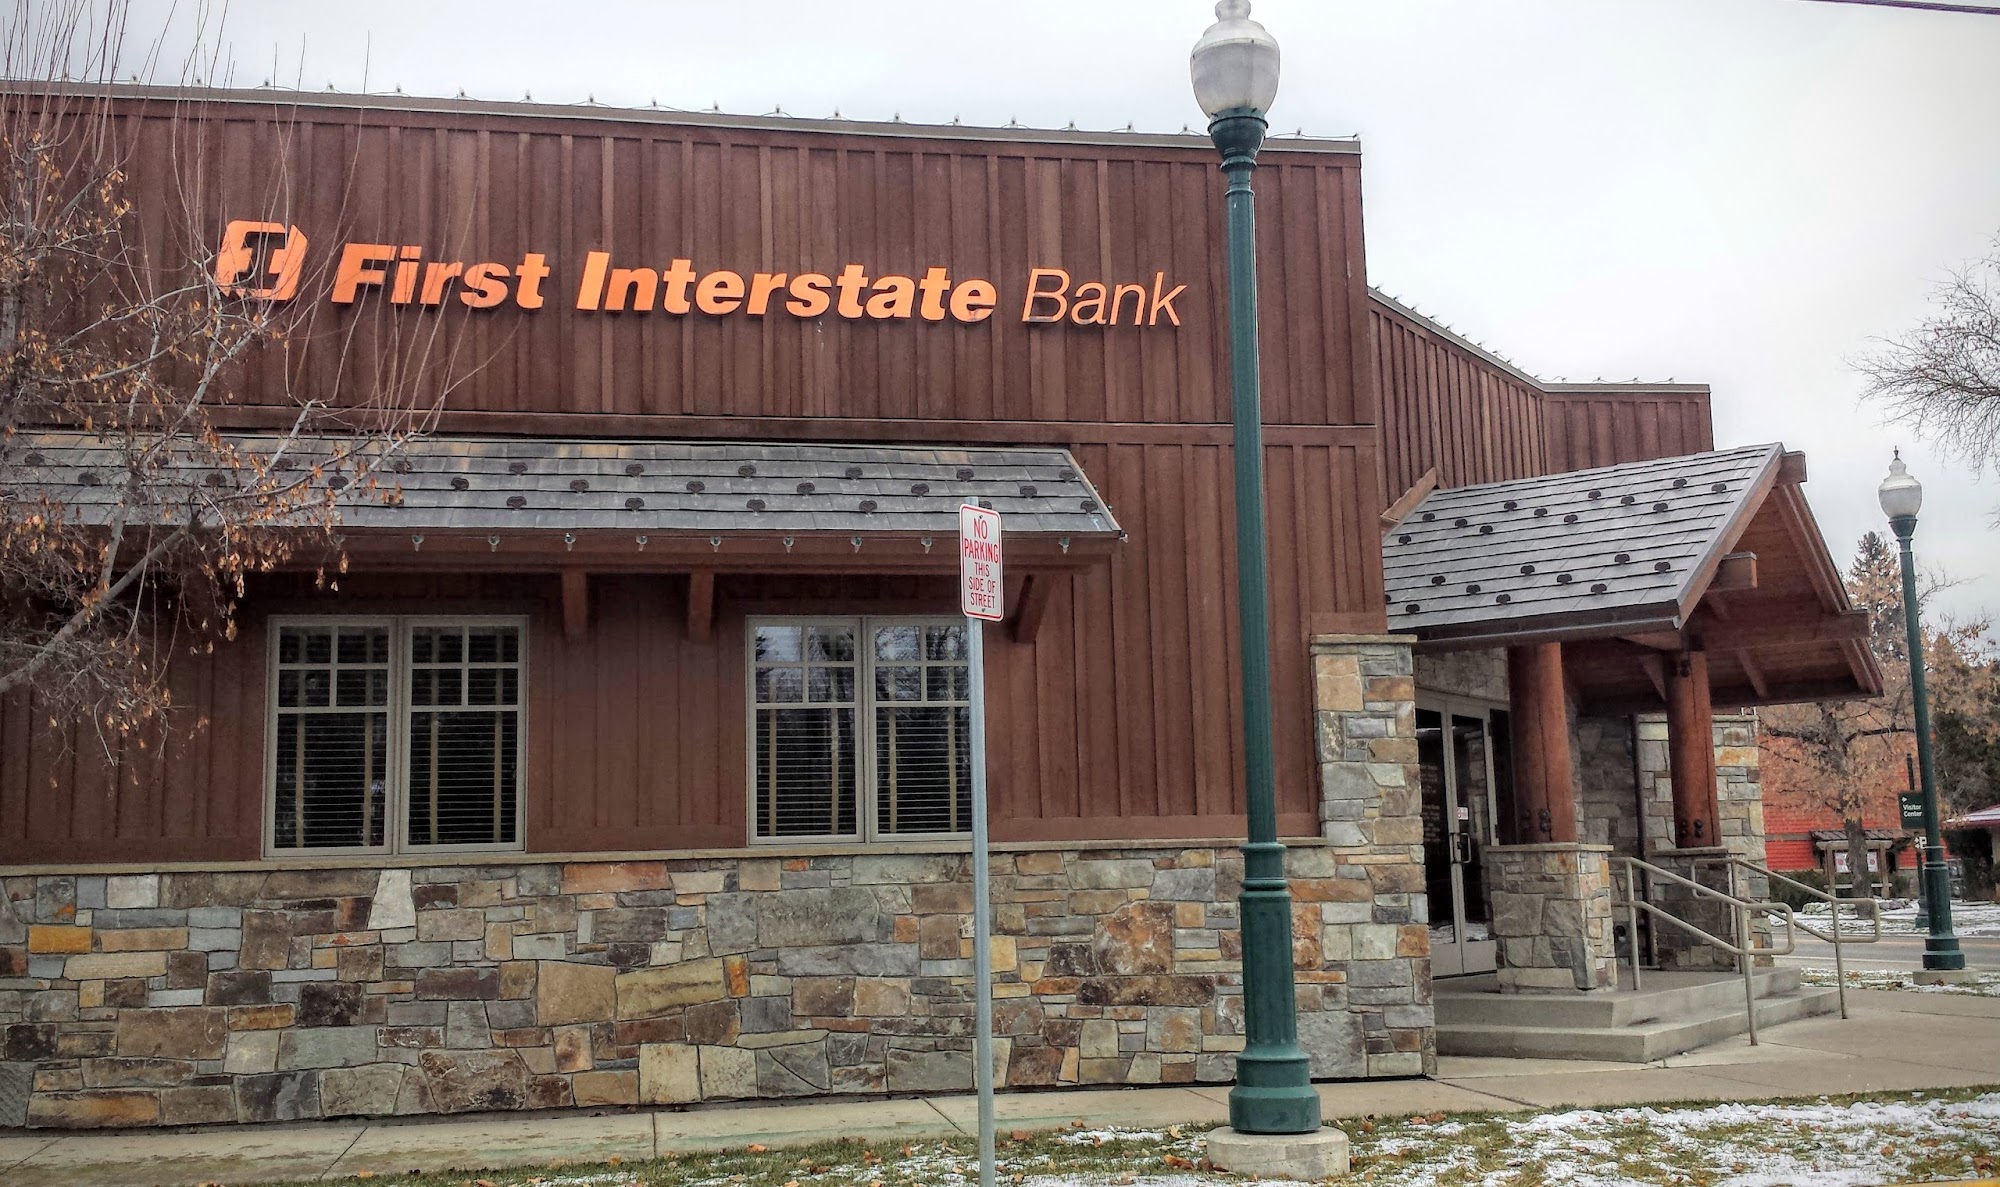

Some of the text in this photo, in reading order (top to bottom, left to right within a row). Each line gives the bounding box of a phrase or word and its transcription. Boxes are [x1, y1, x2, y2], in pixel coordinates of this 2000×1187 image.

[331, 243, 1188, 327] First Interstate Bank
[973, 518, 988, 539] NO
[964, 538, 999, 563] PARKING
[974, 562, 990, 577] THIS
[968, 576, 997, 594] SIDE OF
[970, 592, 995, 609] STREET
